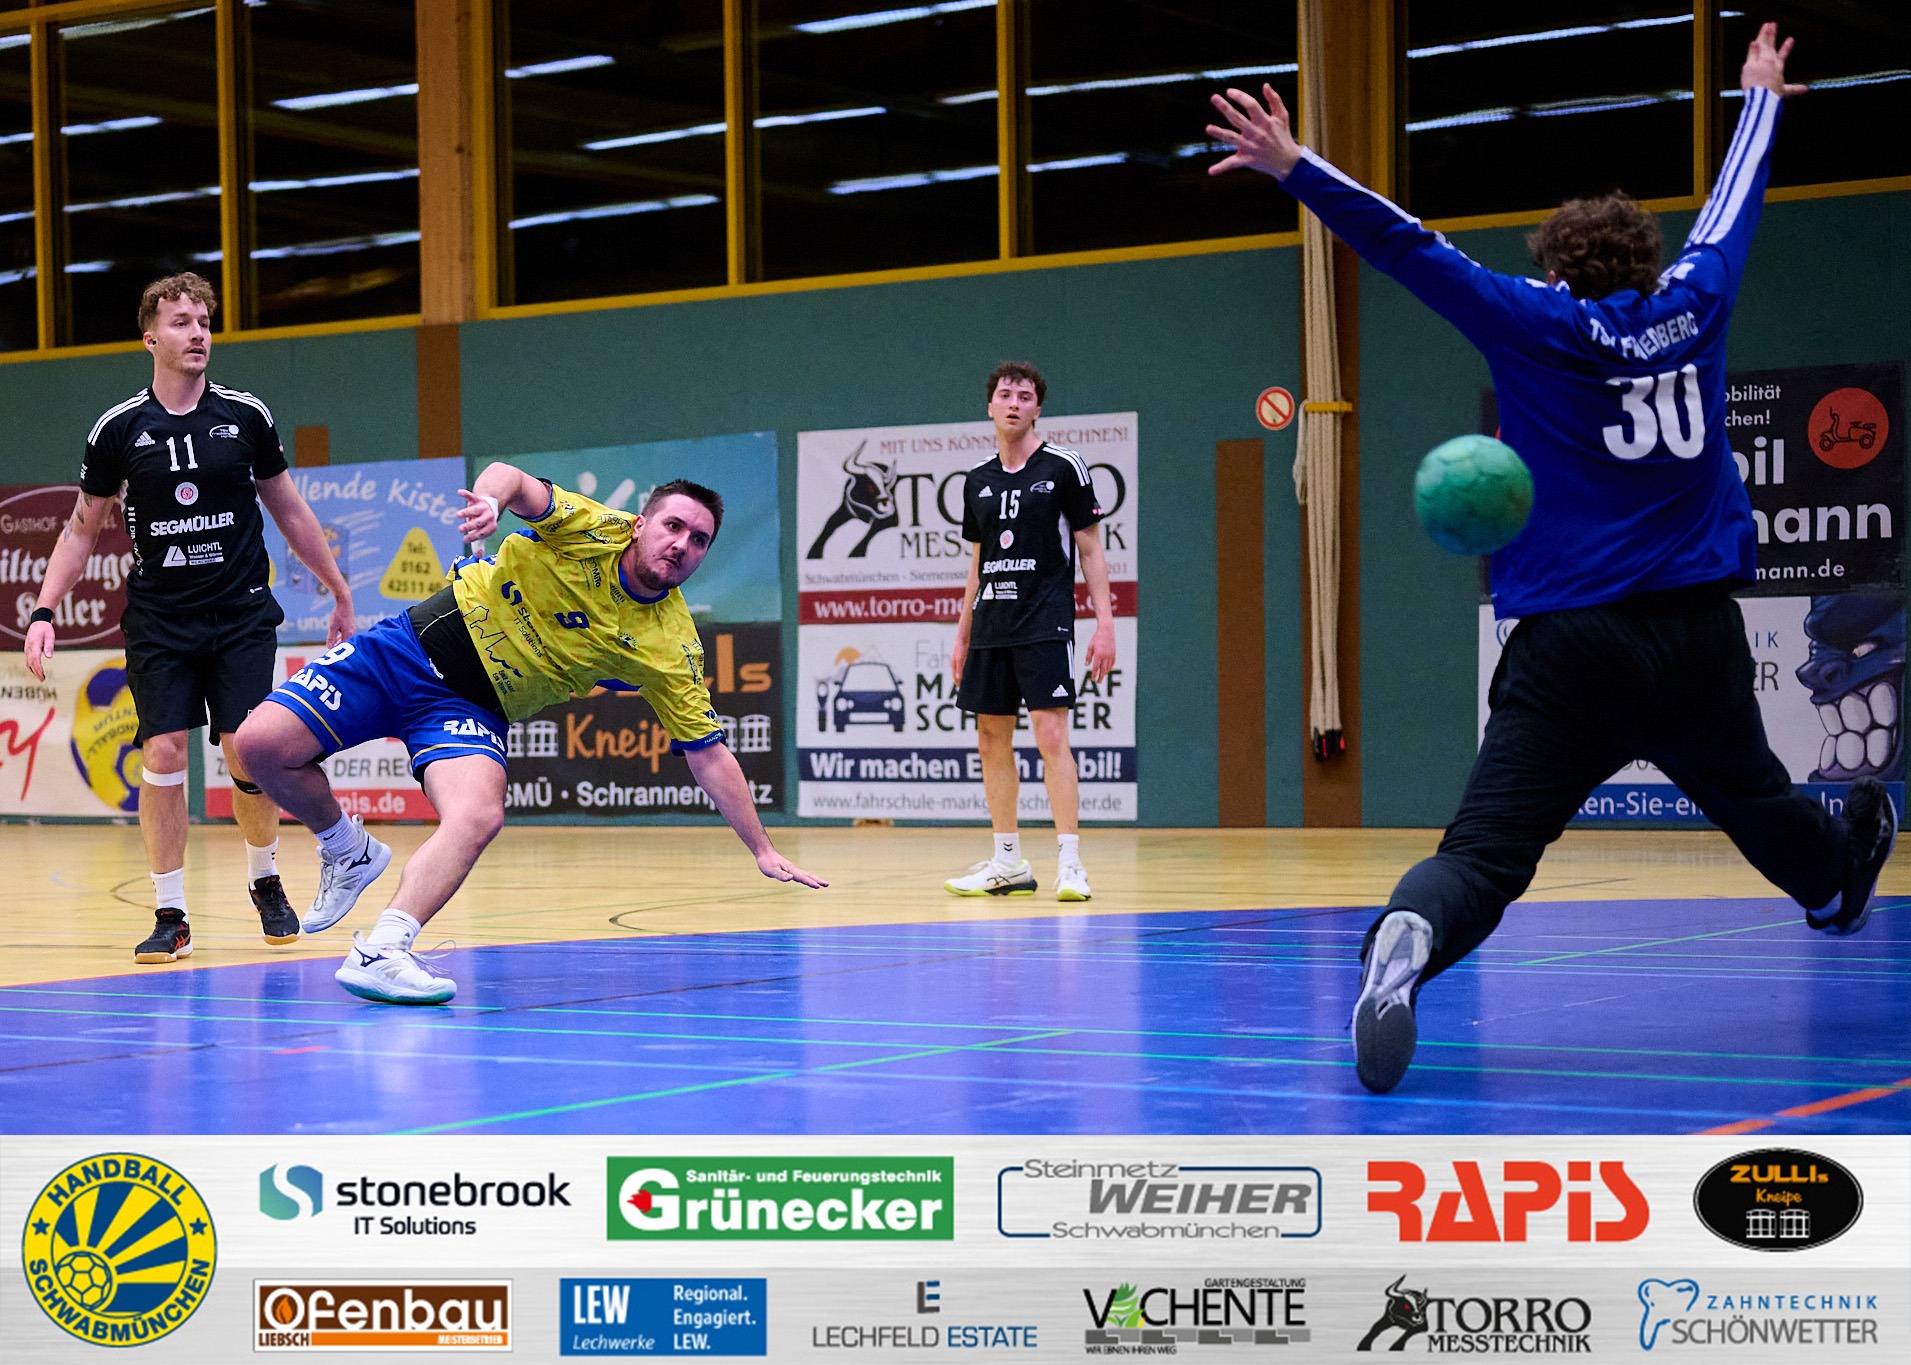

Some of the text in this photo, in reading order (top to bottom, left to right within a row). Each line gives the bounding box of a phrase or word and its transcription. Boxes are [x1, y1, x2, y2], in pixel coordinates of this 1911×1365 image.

[1621, 311, 1699, 361] FREDBERG
[1602, 363, 1706, 460] 30
[1725, 409, 1771, 427] chen!
[166, 433, 198, 471] 11
[880, 438, 907, 454] MIT
[911, 438, 943, 453] UNS
[949, 431, 998, 451] KÖNNE
[1046, 426, 1129, 445] RECHNEN!
[294, 471, 459, 526] llende Kiste
[896, 462, 1126, 527] TOO
[999, 489, 1022, 519] 15
[150, 511, 235, 537] SEGMÜLLER
[187, 541, 223, 554] LUICHTL
[554, 611, 590, 629] 9
[313, 641, 355, 666] 9
[566, 712, 671, 774] Kneip
[333, 758, 371, 777] DER
[810, 752, 855, 779] Wir
[860, 752, 961, 779] machen
[576, 780, 774, 811] Schrannentz
